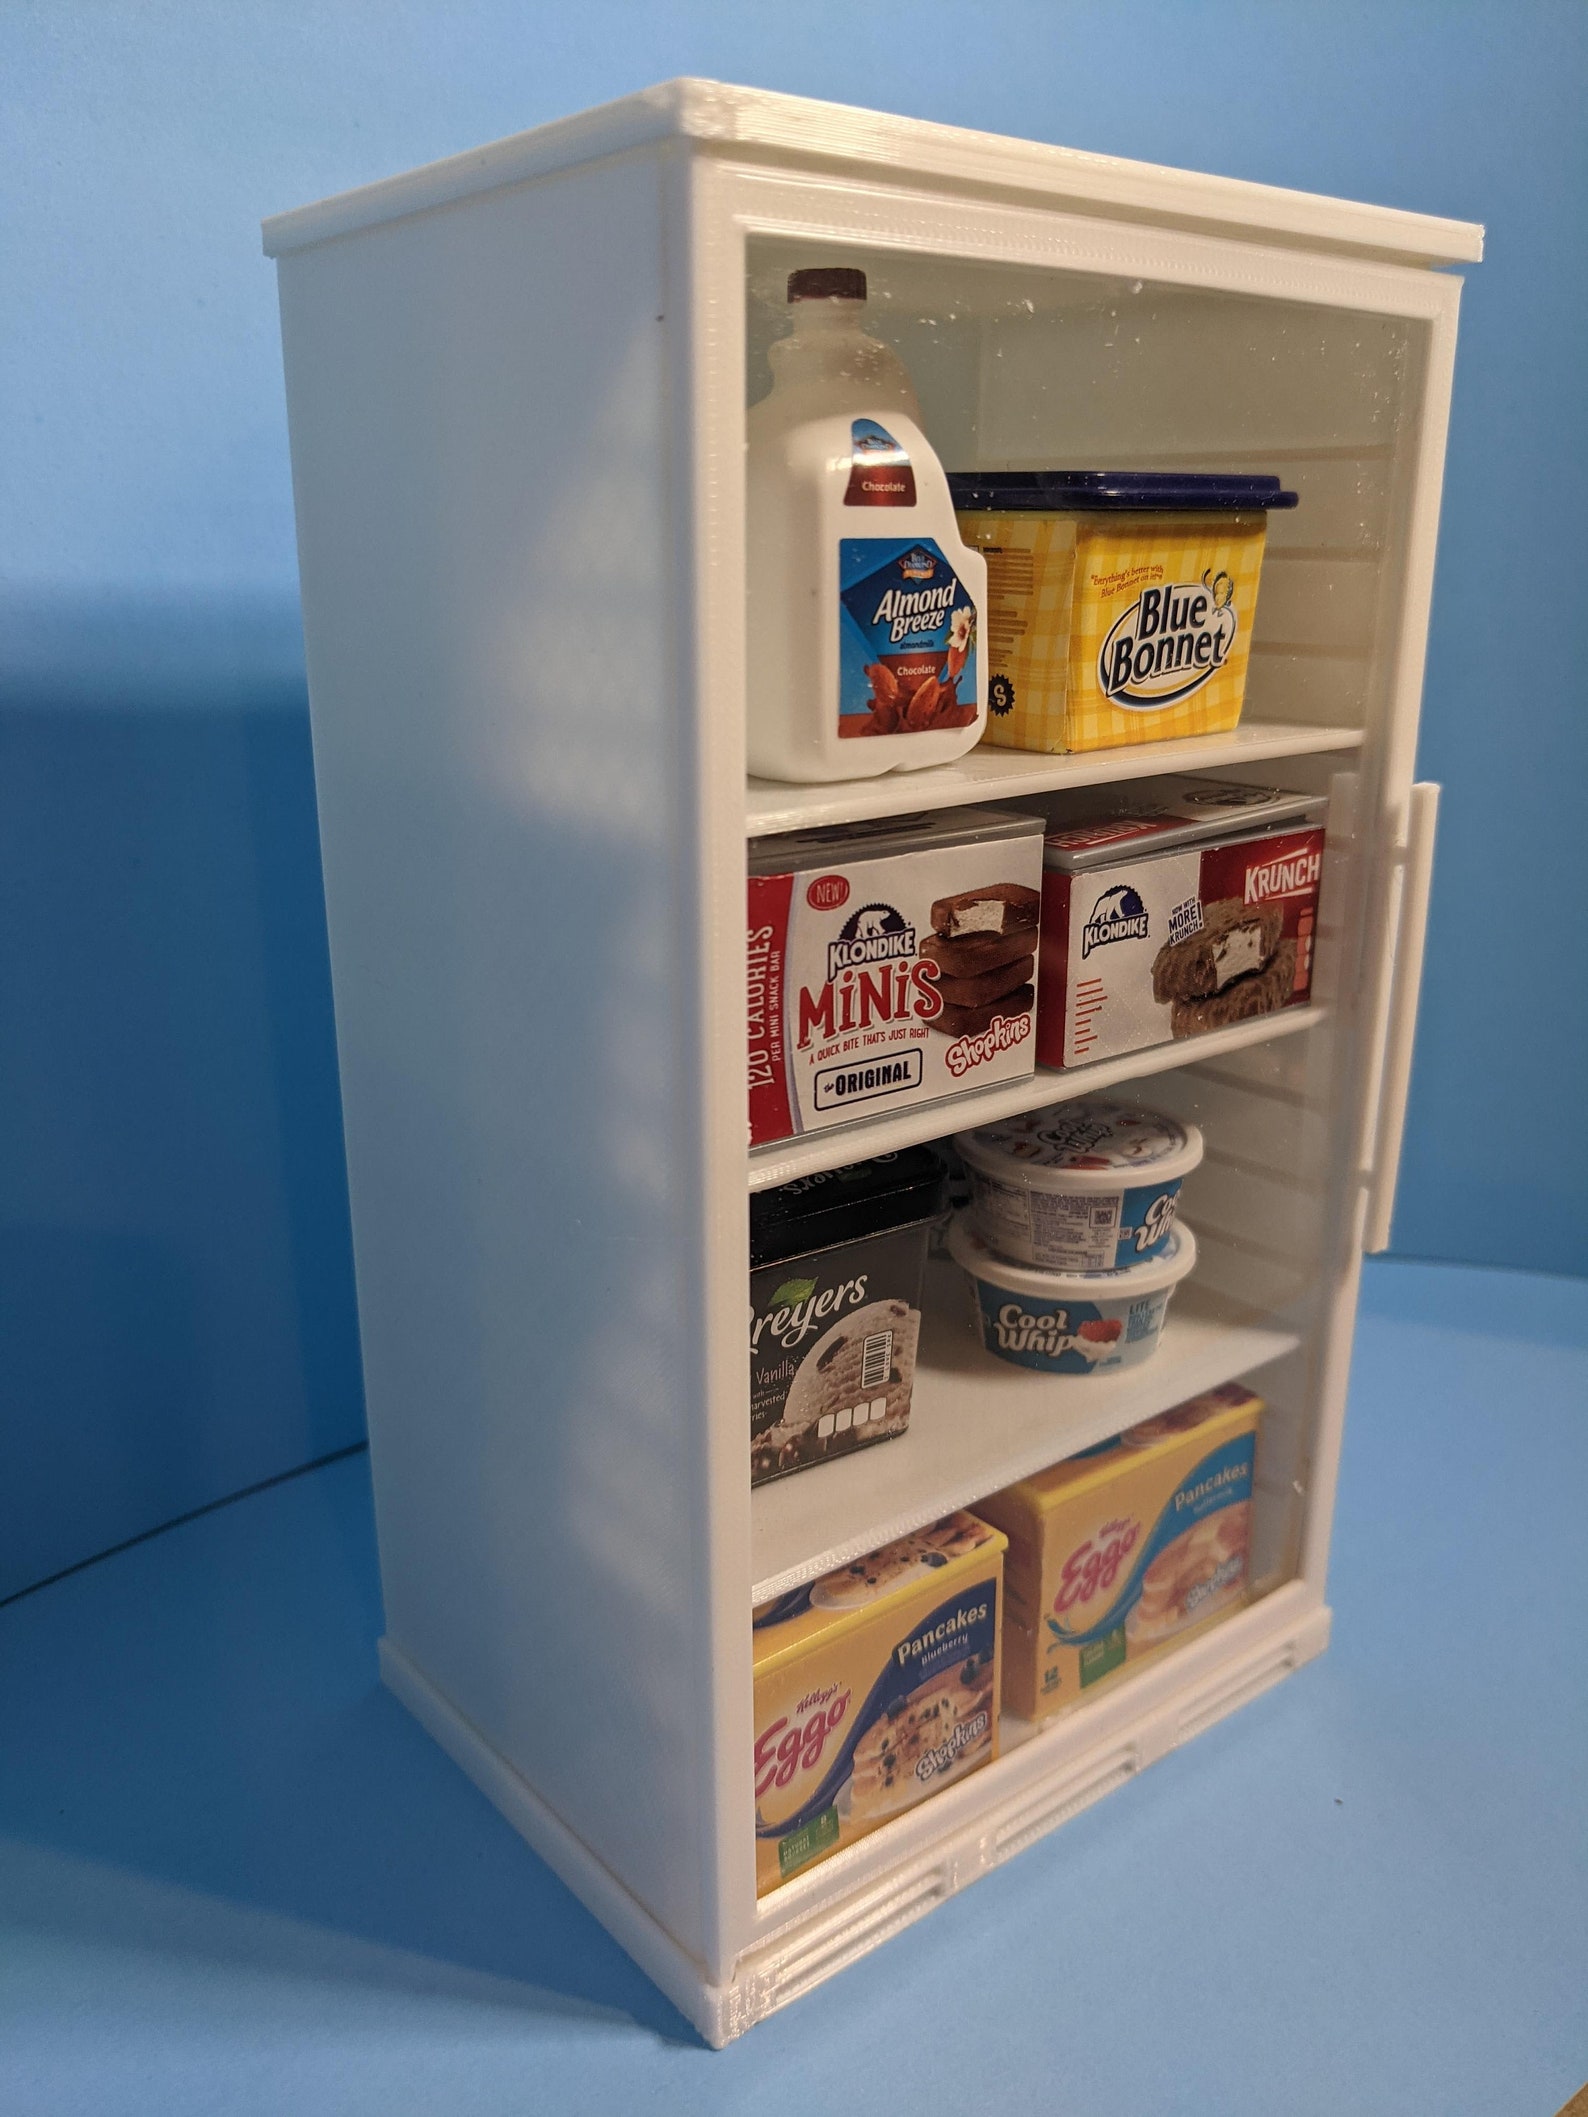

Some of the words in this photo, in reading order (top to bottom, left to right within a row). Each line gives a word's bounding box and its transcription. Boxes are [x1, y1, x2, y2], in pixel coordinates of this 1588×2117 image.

[862, 481, 906, 492] Chocolate
[1131, 565, 1149, 576] better
[1150, 565, 1163, 574] with
[873, 578, 957, 622] Almond
[1138, 585, 1208, 641] Blue
[891, 609, 945, 642] Breeze
[897, 665, 936, 676] Chocolate
[1108, 624, 1226, 692] Bonnet
[816, 881, 844, 904] NEW!
[1244, 854, 1320, 905] KRUNCH
[828, 929, 916, 982] KLONDIKE
[1083, 914, 1149, 959] KLONDIKE
[770, 950, 781, 976] BAR
[746, 925, 774, 1040] CALORIES
[769, 981, 780, 1012] SNACK
[770, 1015, 781, 1038] MINI
[945, 1013, 1031, 1078] Shopkins
[772, 1044, 782, 1062] PER
[808, 1050, 815, 1065] A
[817, 1043, 840, 1065] QUICK
[843, 1037, 859, 1053] BITE
[863, 1030, 886, 1047] THAT'S
[889, 1029, 906, 1041] JUST
[910, 1027, 930, 1039] RIGHT
[835, 1061, 912, 1097] ORIGINAL
[1000, 1304, 1067, 1330] Cool
[995, 1323, 1074, 1357] Whip
[755, 1359, 795, 1385] Vanilla
[1175, 1462, 1248, 1512] Pancakes
[1053, 1522, 1141, 1613] Eggo
[897, 1601, 988, 1664] Pancakes
[755, 1689, 851, 1798] Eggo
[914, 1710, 988, 1782] Shopkins
